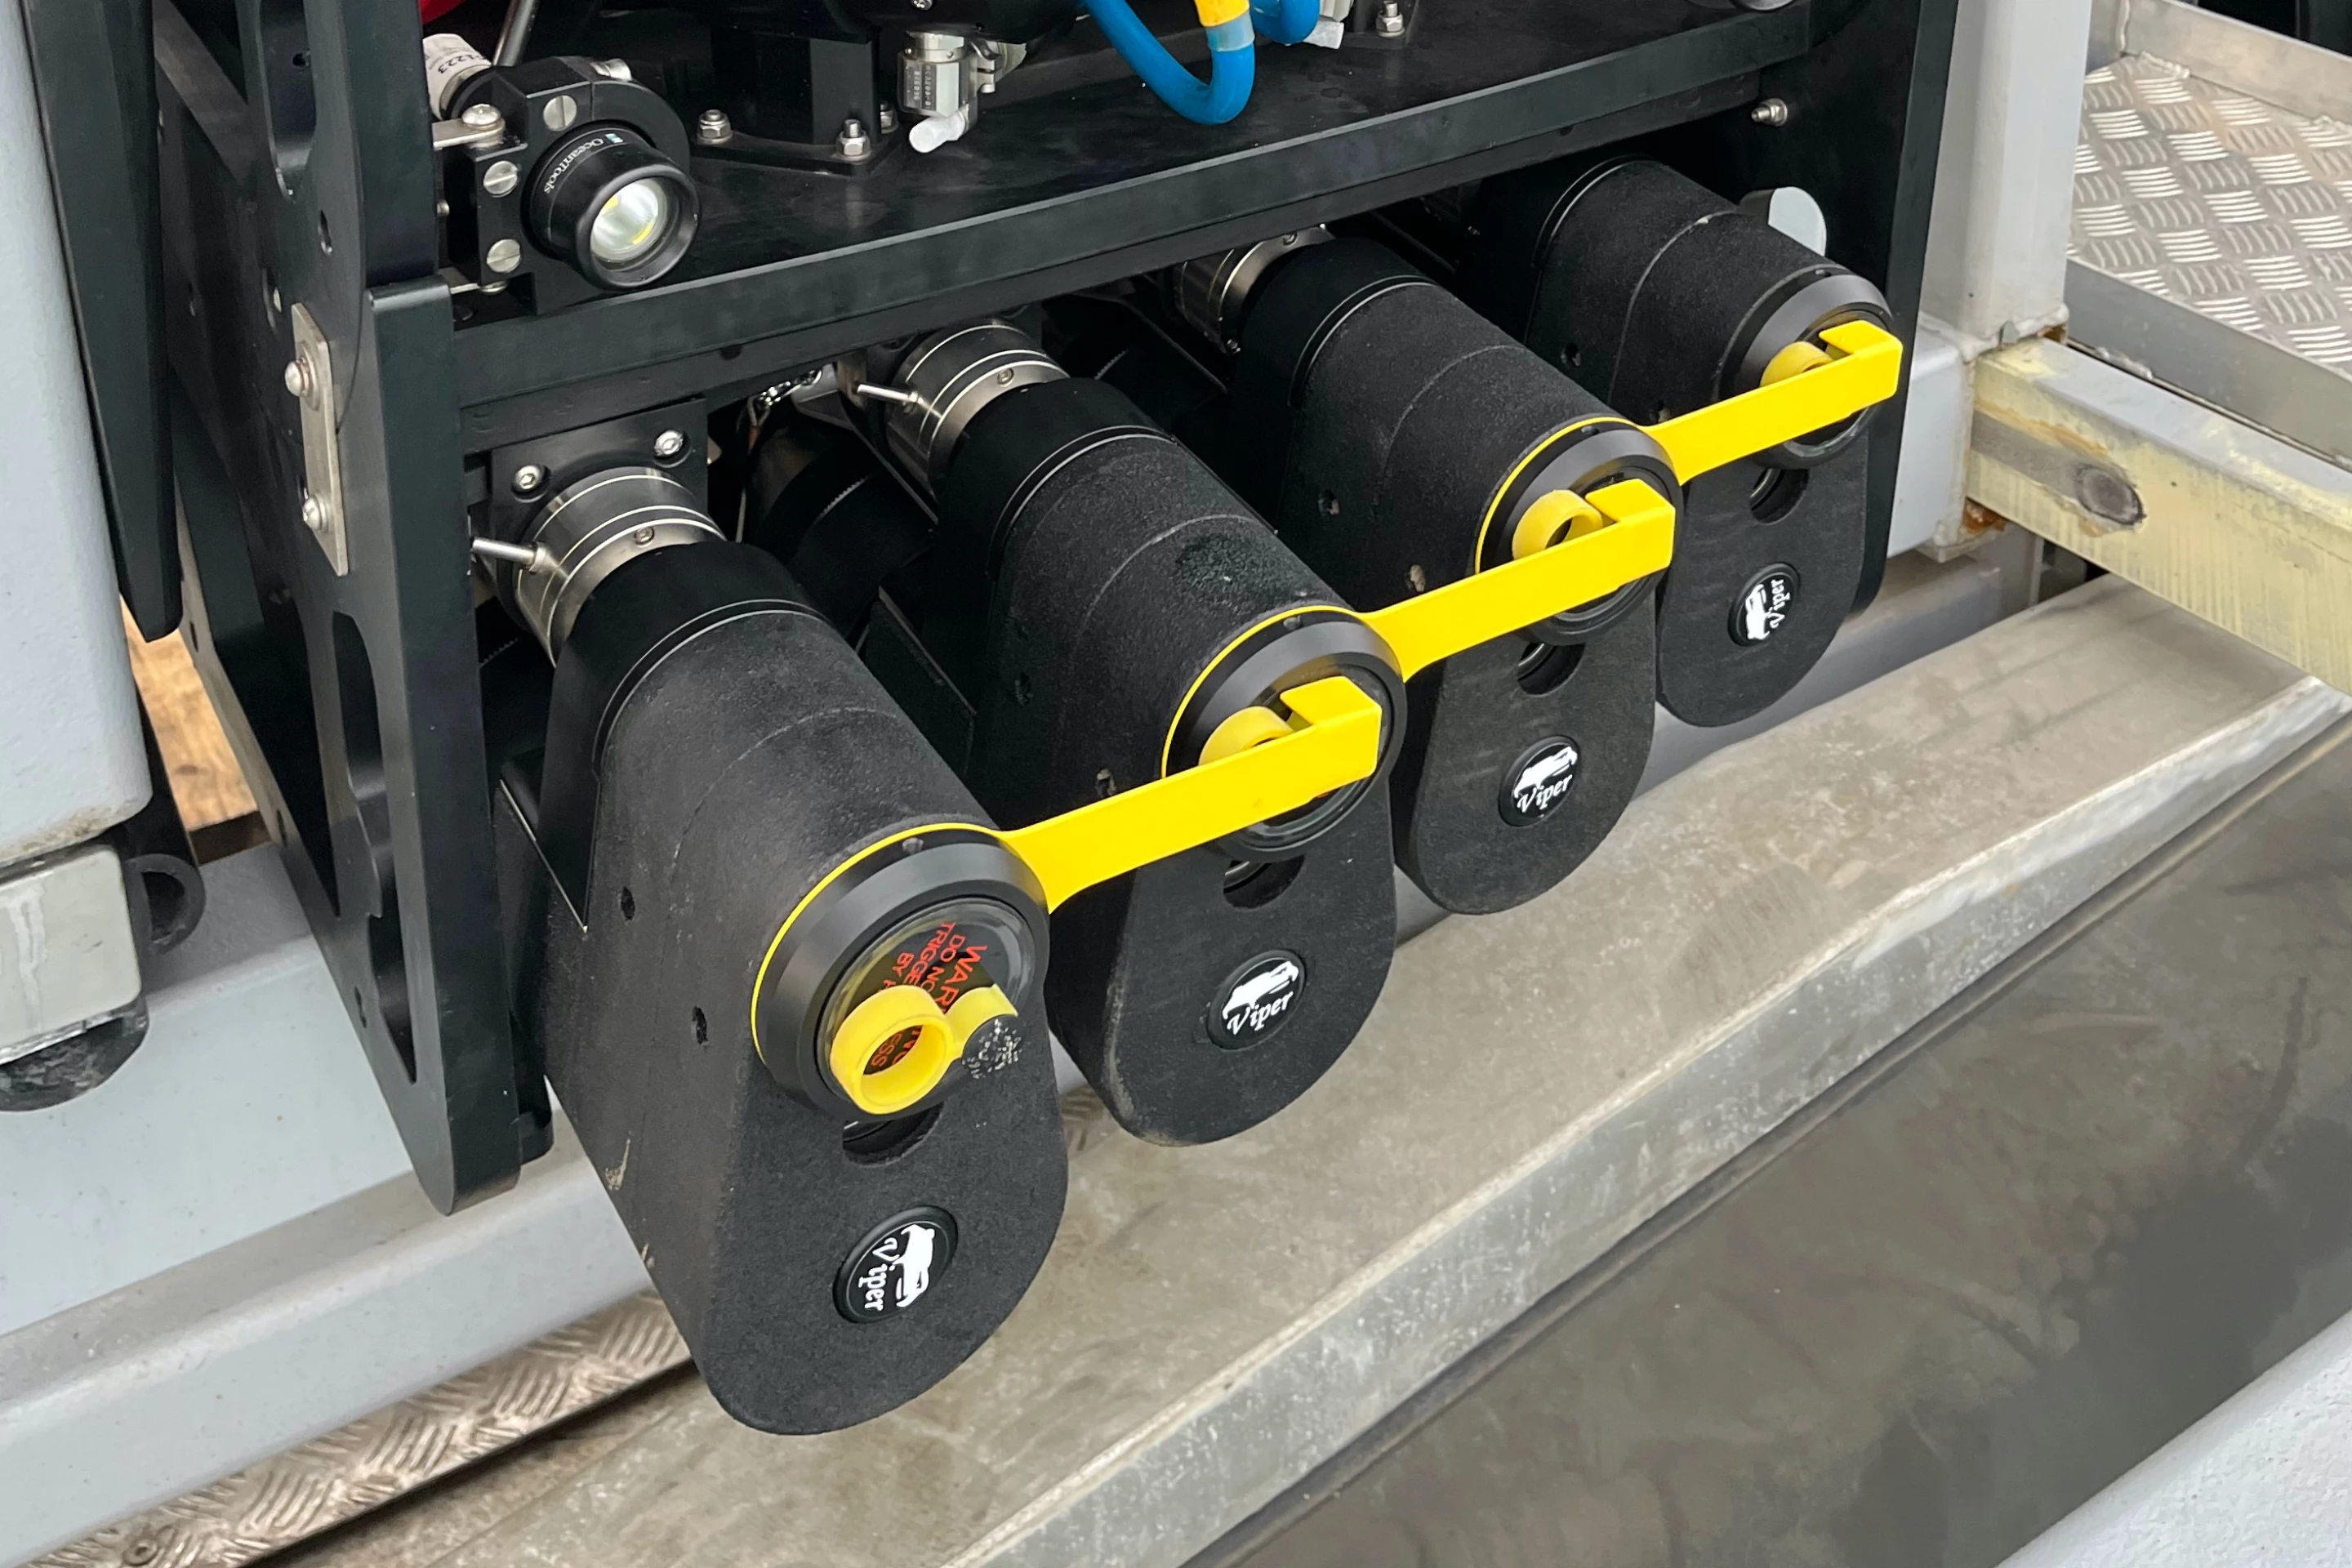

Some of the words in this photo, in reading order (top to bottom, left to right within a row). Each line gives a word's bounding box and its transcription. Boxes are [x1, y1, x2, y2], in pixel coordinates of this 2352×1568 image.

[543, 137, 604, 194] OceanTools
[1766, 578, 1791, 629] Viper
[1517, 773, 1573, 813] Viper
[903, 921, 956, 986] TRIGGE
[940, 933, 966, 963] DO
[920, 965, 945, 993] NO
[1226, 991, 1294, 1036] Viper
[858, 1236, 900, 1312] Viper
